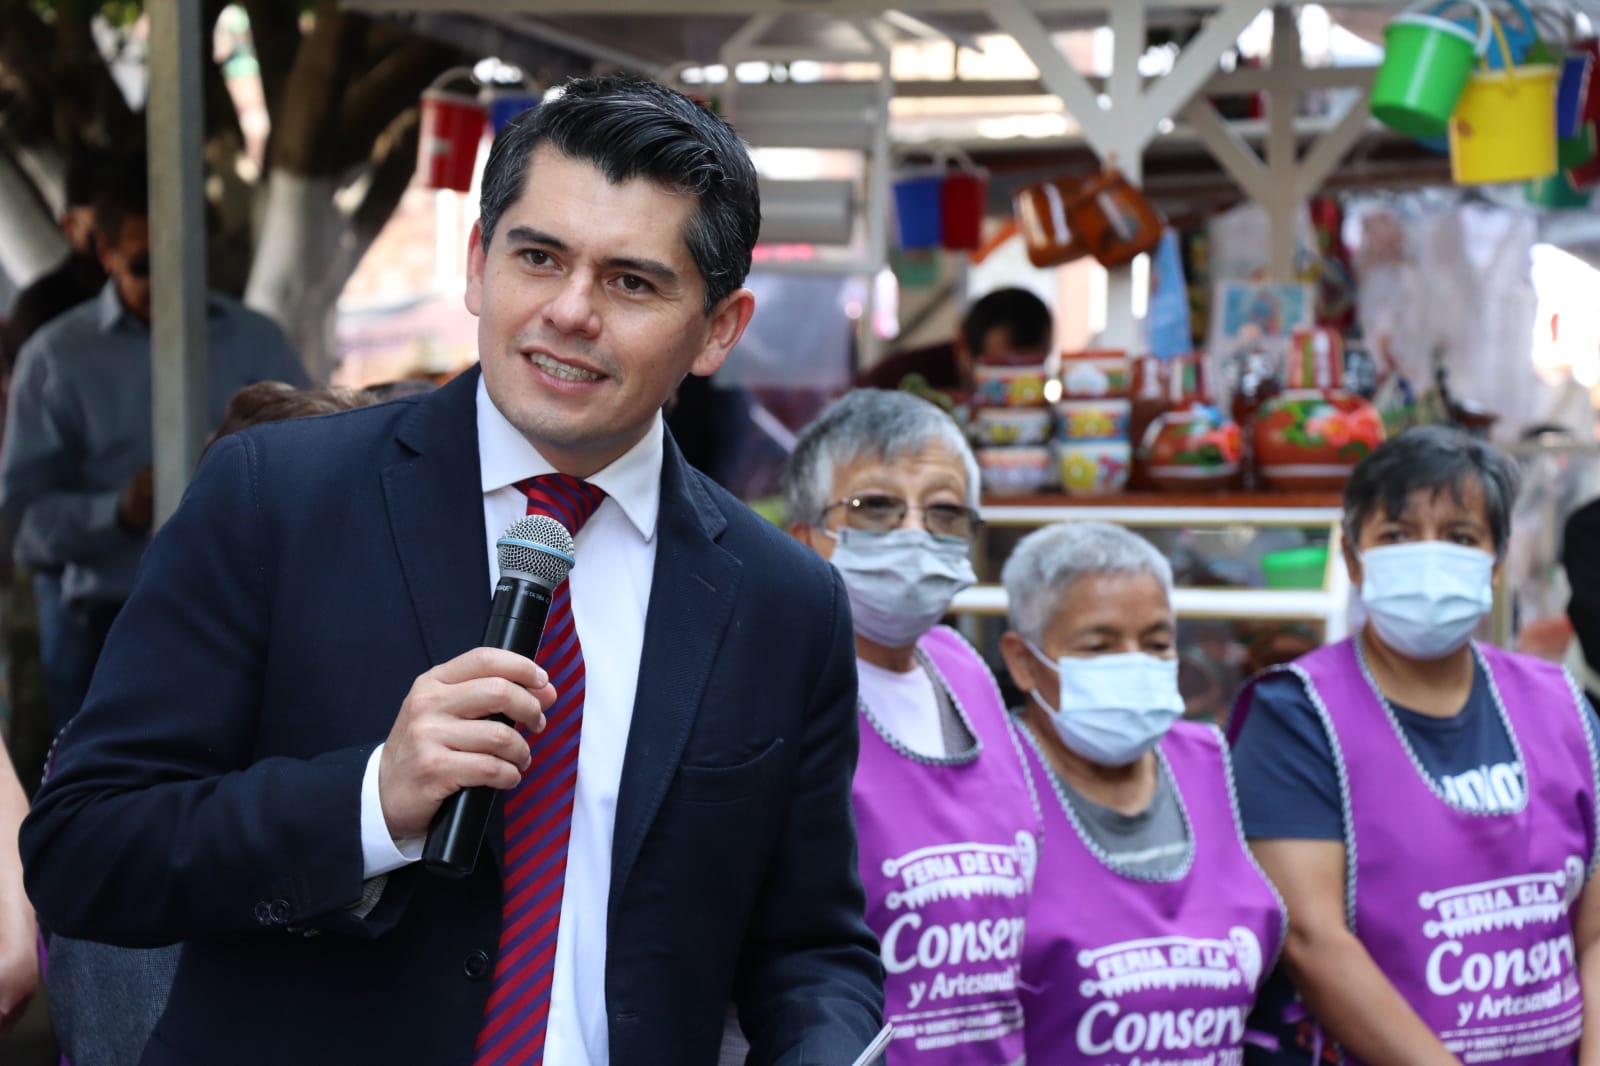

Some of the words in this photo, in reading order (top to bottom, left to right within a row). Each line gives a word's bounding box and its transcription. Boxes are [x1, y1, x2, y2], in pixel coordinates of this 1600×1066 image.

[900, 853, 961, 890] FERIA
[958, 851, 992, 876] DE
[989, 852, 1016, 878] LA
[1438, 887, 1514, 921] FERIA
[1096, 947, 1169, 980] FERIA
[1168, 946, 1202, 968] DE
[1202, 947, 1229, 969] LA
[907, 981, 926, 1009] y
[1456, 1001, 1474, 1027] y
